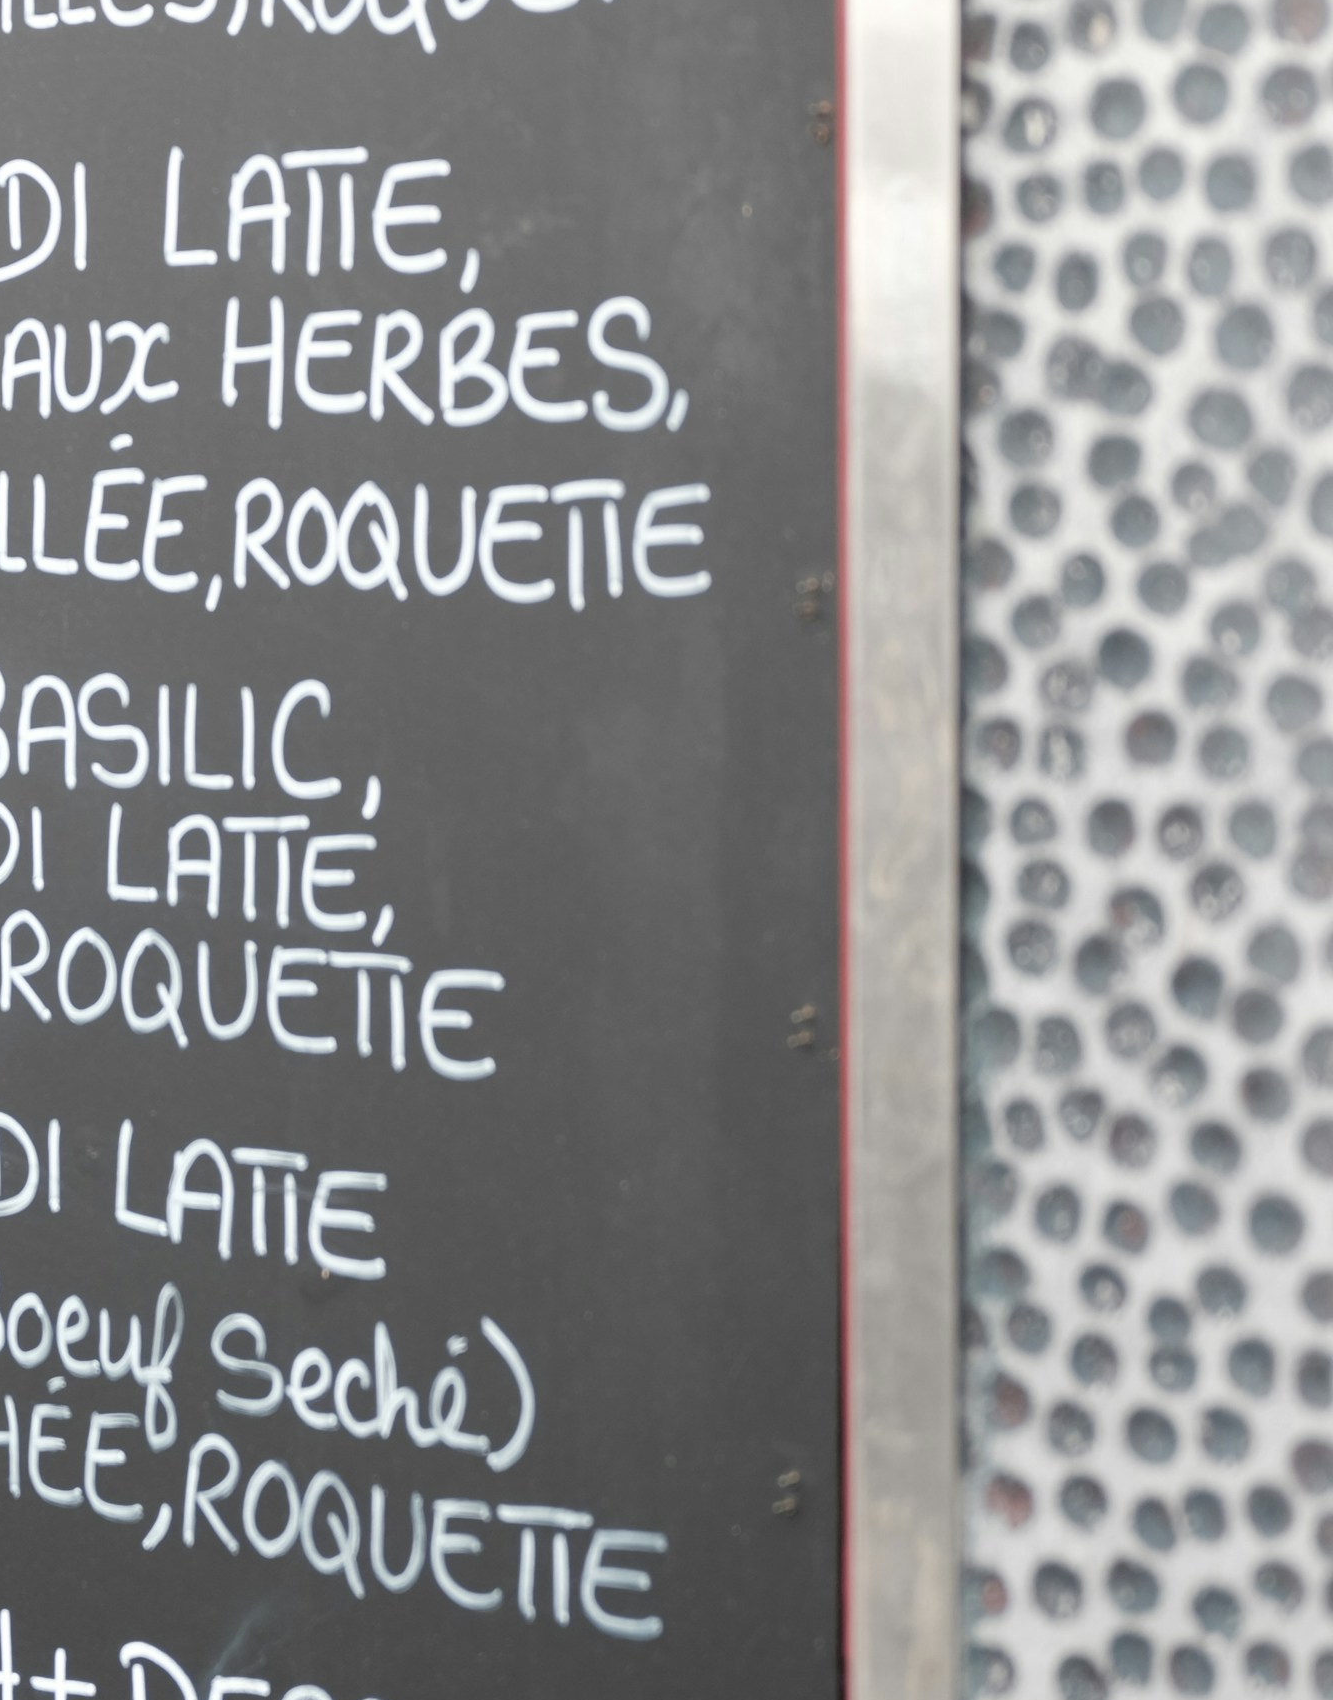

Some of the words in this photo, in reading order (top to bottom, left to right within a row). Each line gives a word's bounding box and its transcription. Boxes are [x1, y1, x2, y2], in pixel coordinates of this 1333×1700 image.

[234, 478, 711, 611] ROQUETTE
[0, 905, 504, 1079] ROQUETTE
[115, 1119, 386, 1279] LATTE
[183, 1433, 666, 1636] ROQUETTE
